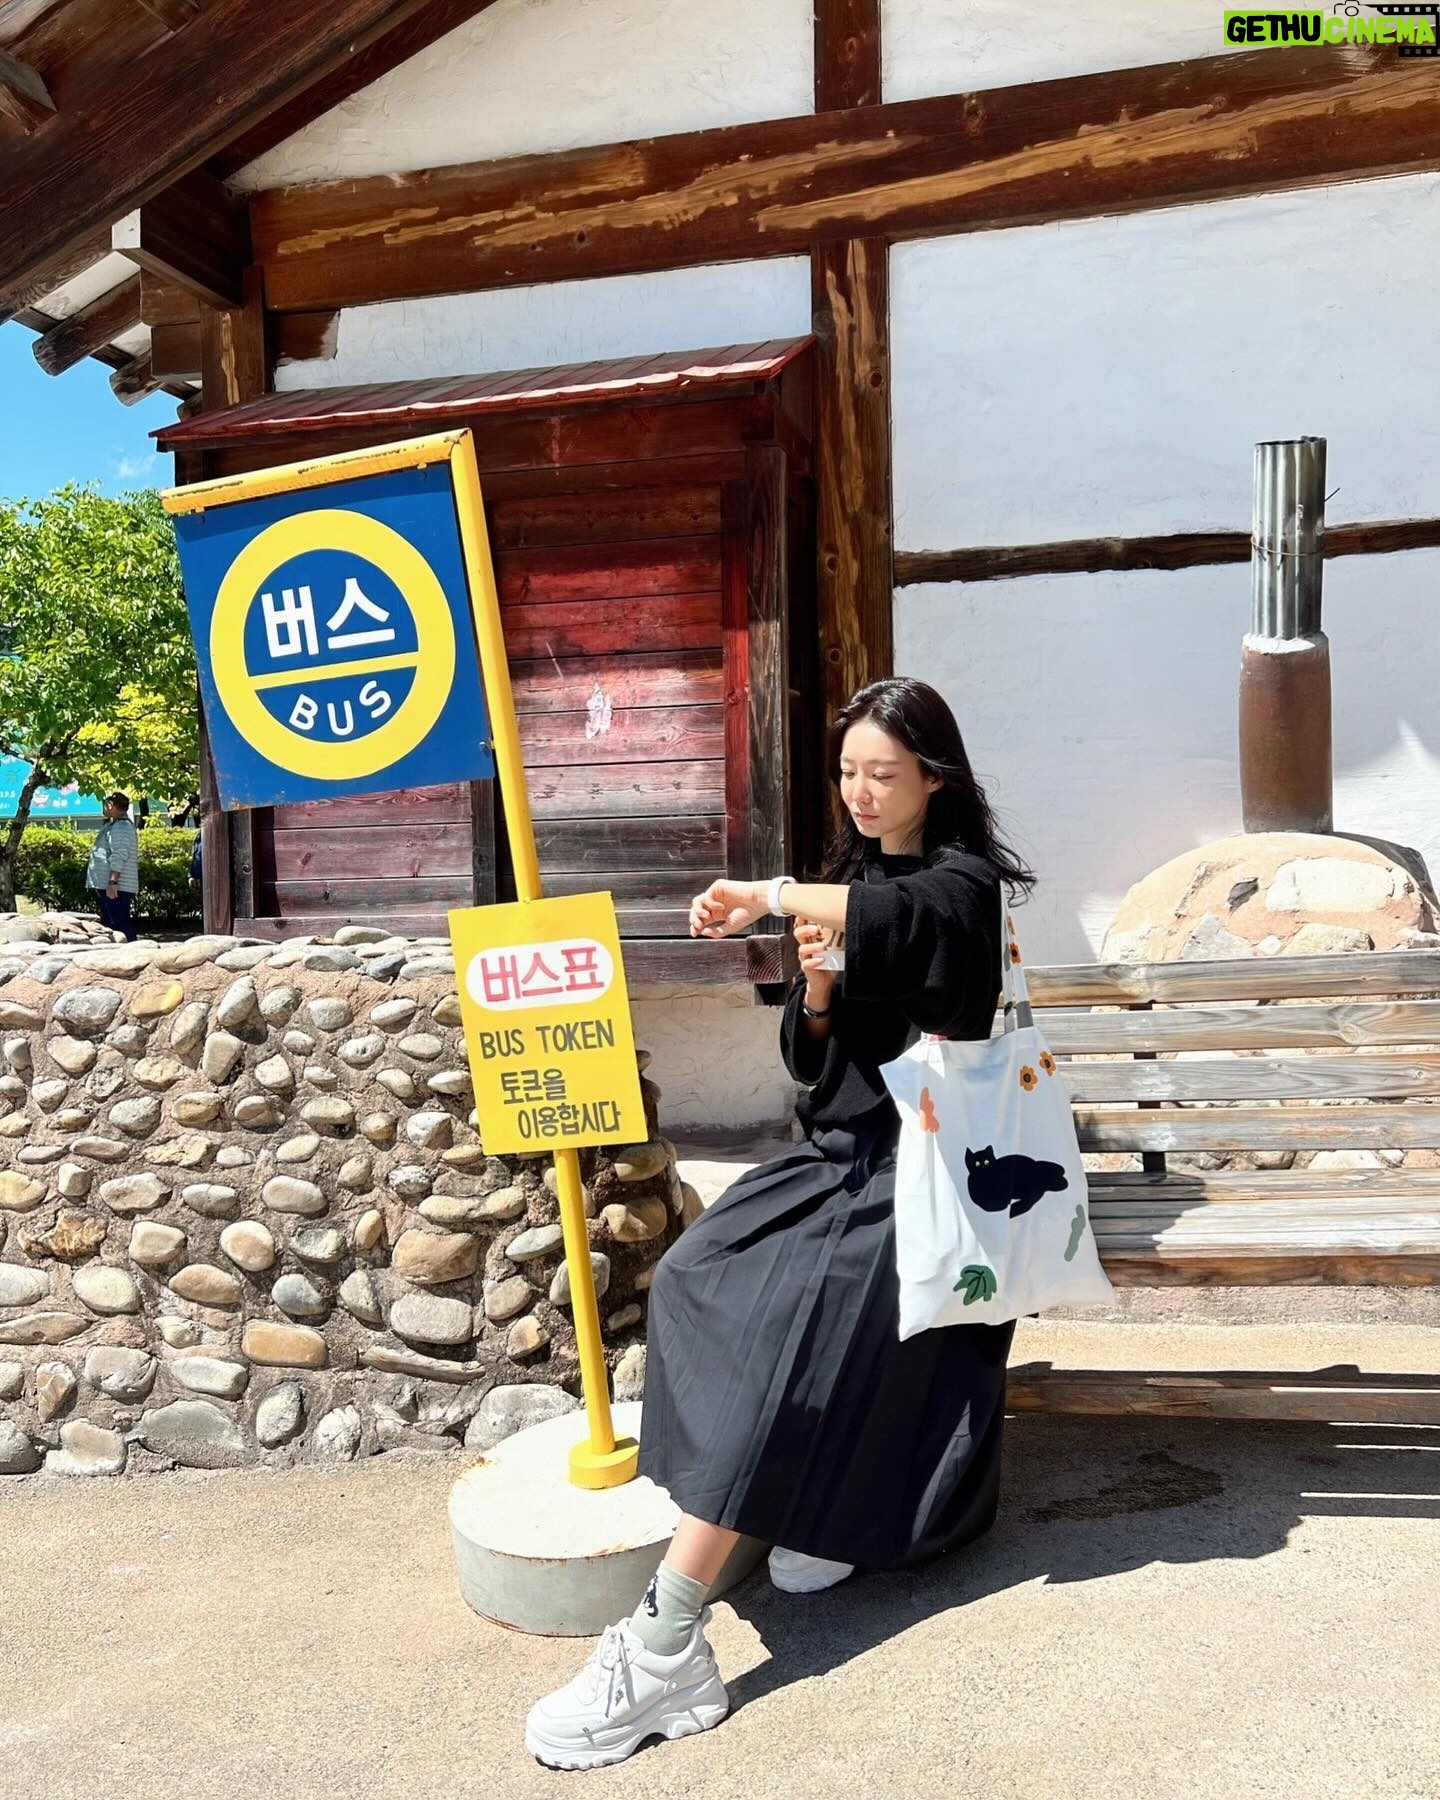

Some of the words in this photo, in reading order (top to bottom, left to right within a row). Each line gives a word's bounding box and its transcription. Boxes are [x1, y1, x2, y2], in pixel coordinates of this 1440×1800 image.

[261, 577, 396, 658] 버스
[288, 680, 392, 736] BUS
[480, 946, 605, 1003] 버스표
[479, 1028, 525, 1059] BUS
[536, 1019, 615, 1054] TOKEN
[500, 1067, 567, 1105] 토큰을
[518, 1101, 622, 1139] 이용합시다
